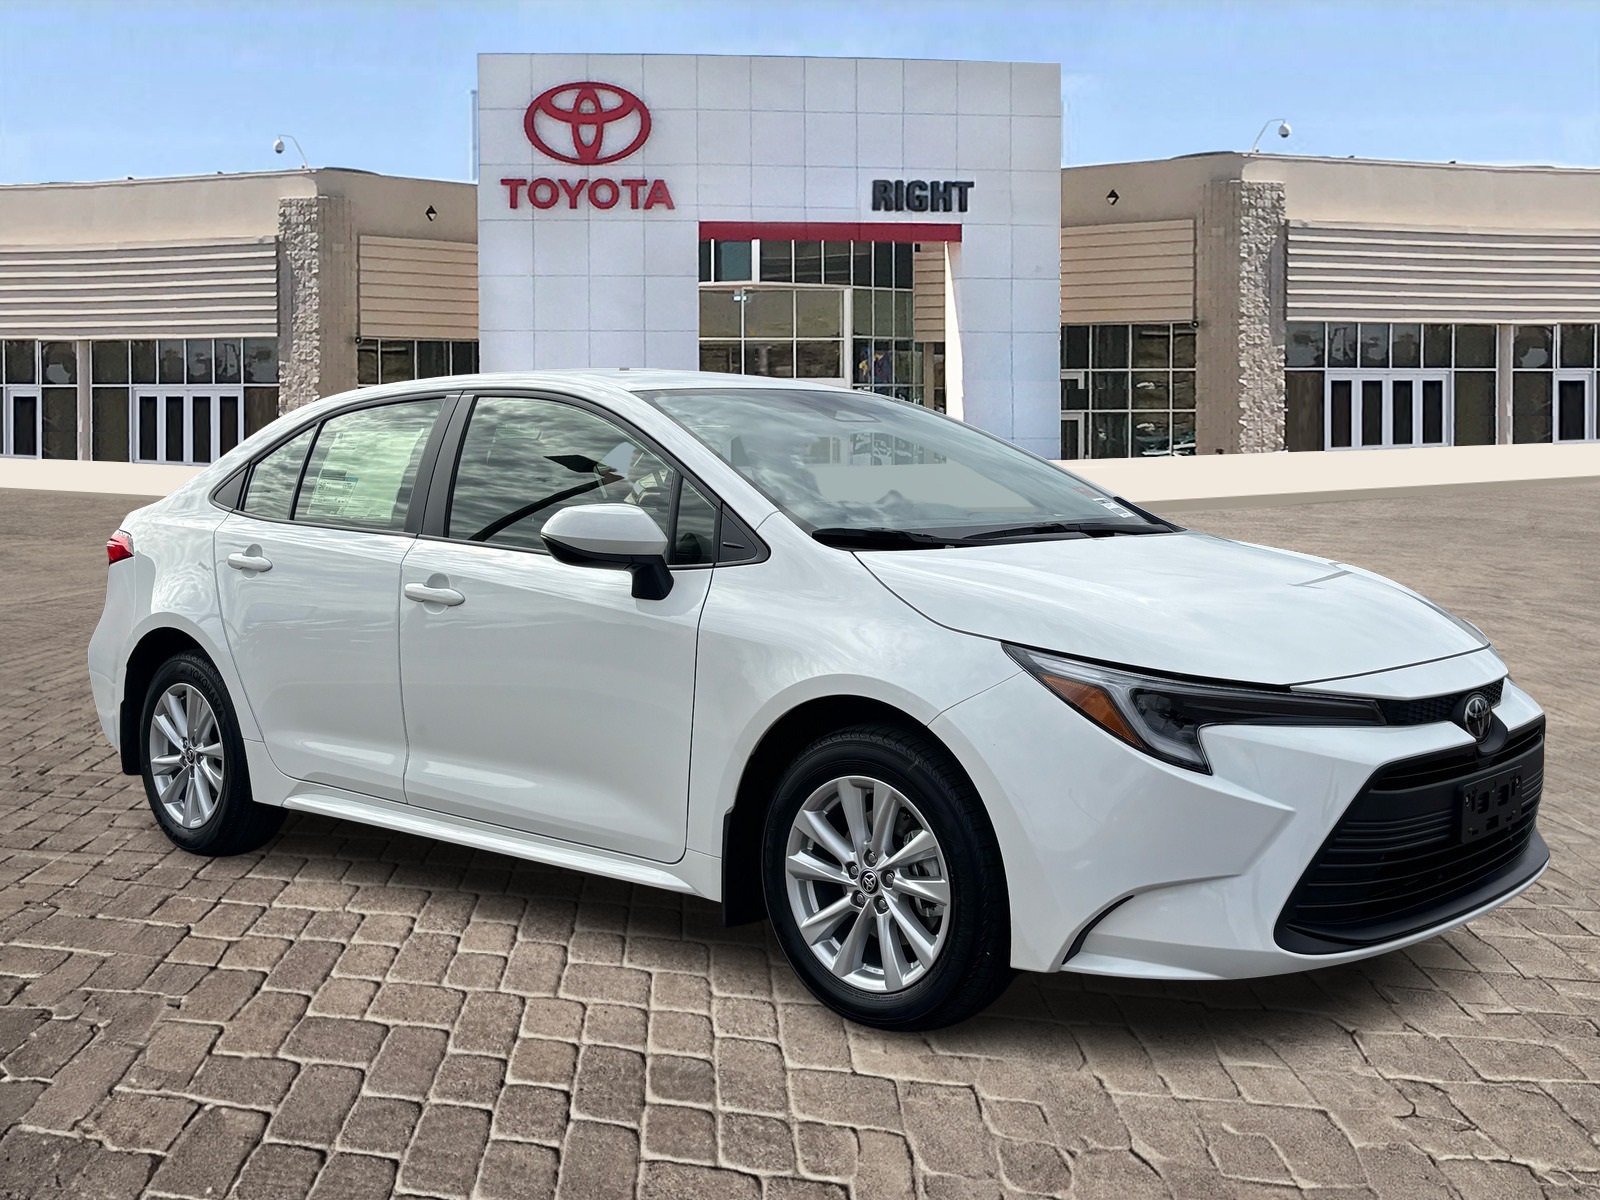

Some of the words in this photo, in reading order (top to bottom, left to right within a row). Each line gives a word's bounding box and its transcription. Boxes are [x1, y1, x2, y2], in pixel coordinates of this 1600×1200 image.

[501, 178, 675, 210] TOYOTA
[872, 179, 975, 213] RIGHT
[190, 667, 224, 718] YOKOHAMA
